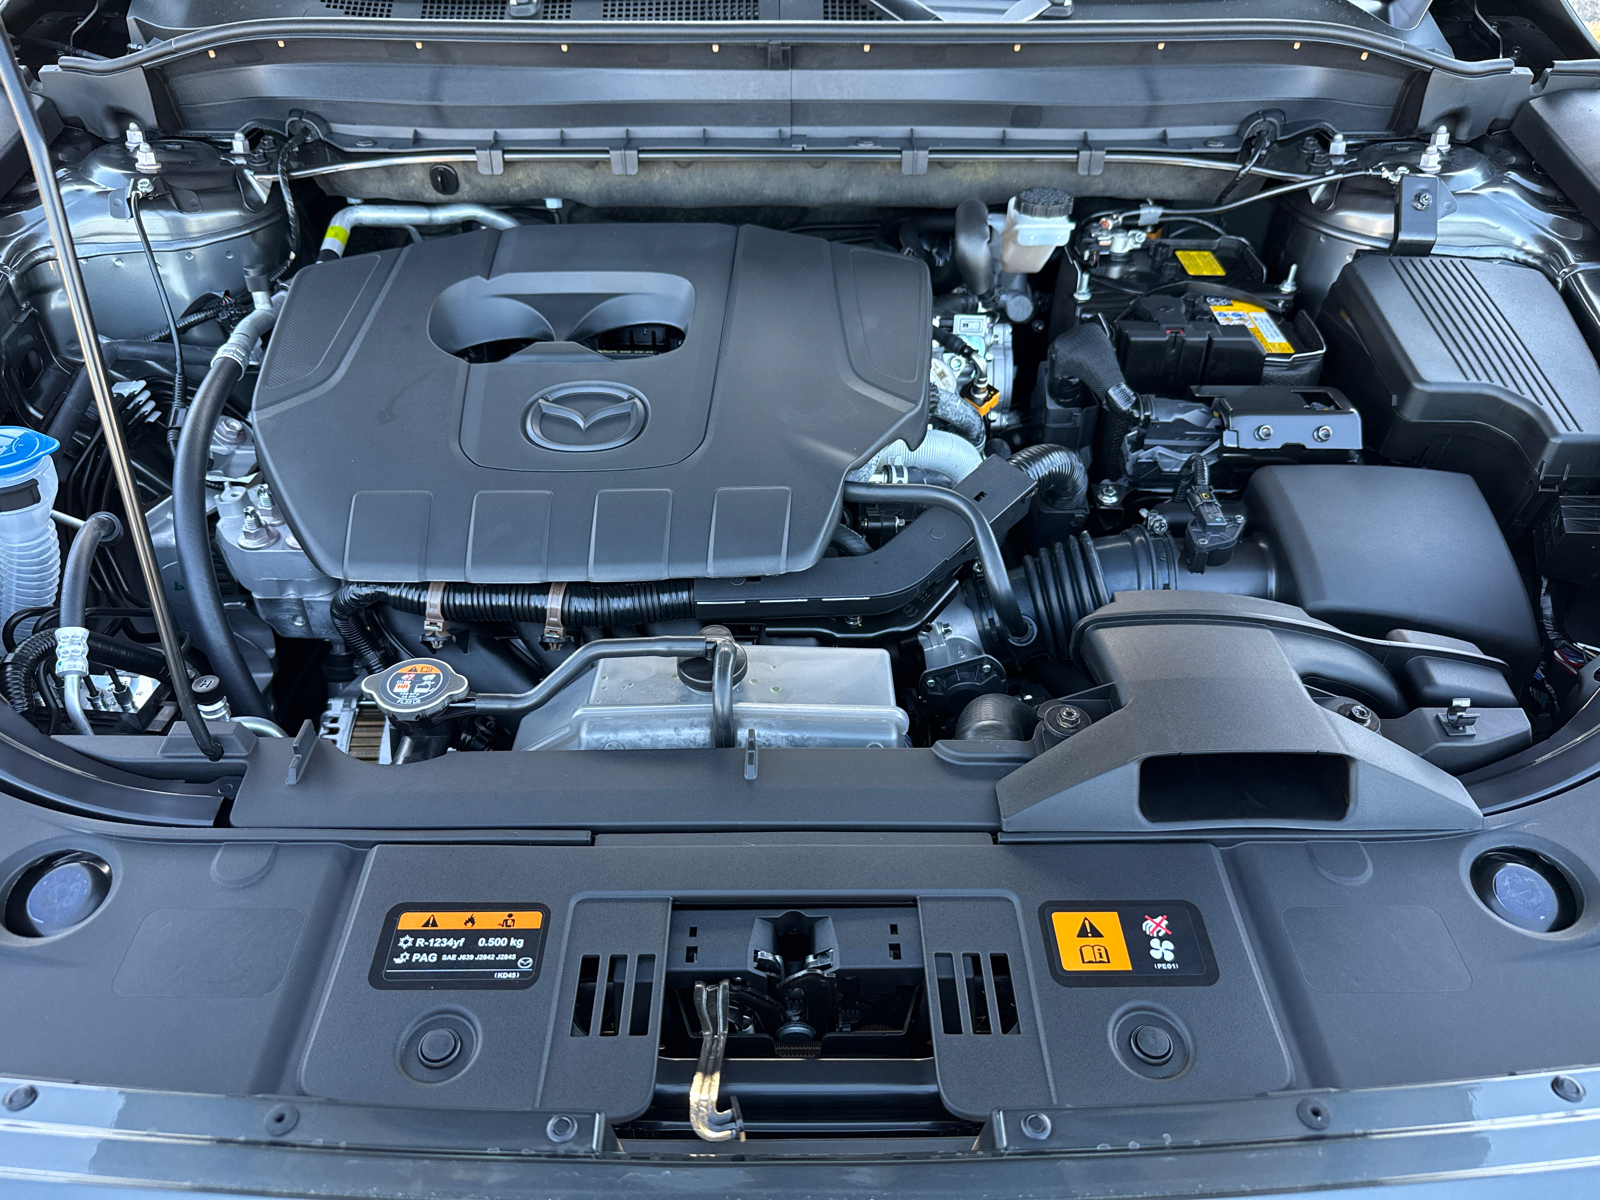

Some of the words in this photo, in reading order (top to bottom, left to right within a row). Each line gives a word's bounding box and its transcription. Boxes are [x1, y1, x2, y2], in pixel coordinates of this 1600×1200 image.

[415, 937, 465, 949] R-1234yf
[477, 937, 508, 948] 0.500
[509, 937, 525, 949] kg
[411, 952, 438, 963] PAG
[441, 953, 457, 961] SAE
